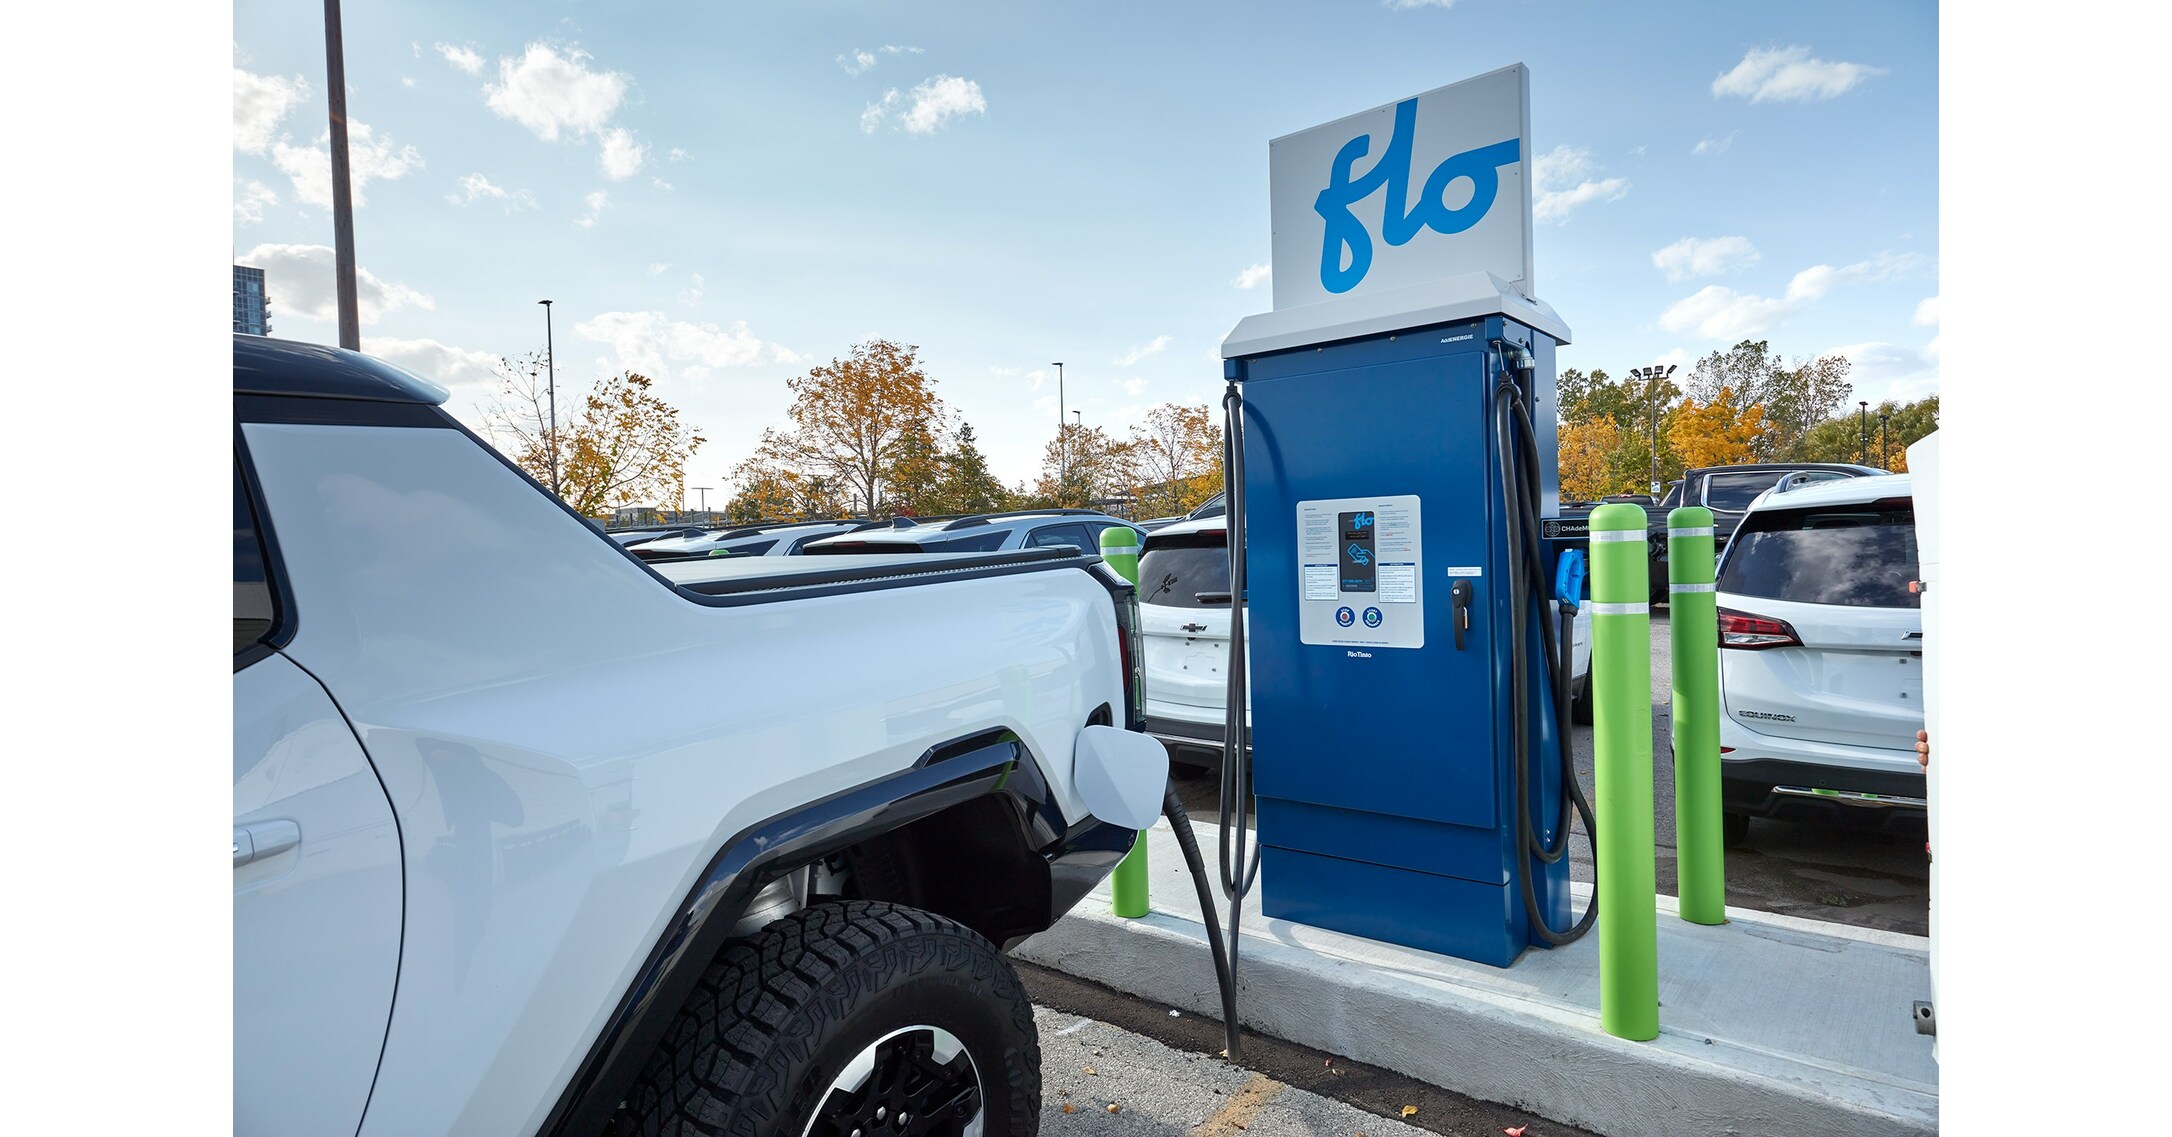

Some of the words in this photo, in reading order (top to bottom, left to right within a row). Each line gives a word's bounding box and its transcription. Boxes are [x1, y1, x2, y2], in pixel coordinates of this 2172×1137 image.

[1313, 97, 1520, 294] flo
[1353, 512, 1374, 530] flo
[1738, 710, 1796, 722] EQUINOX
